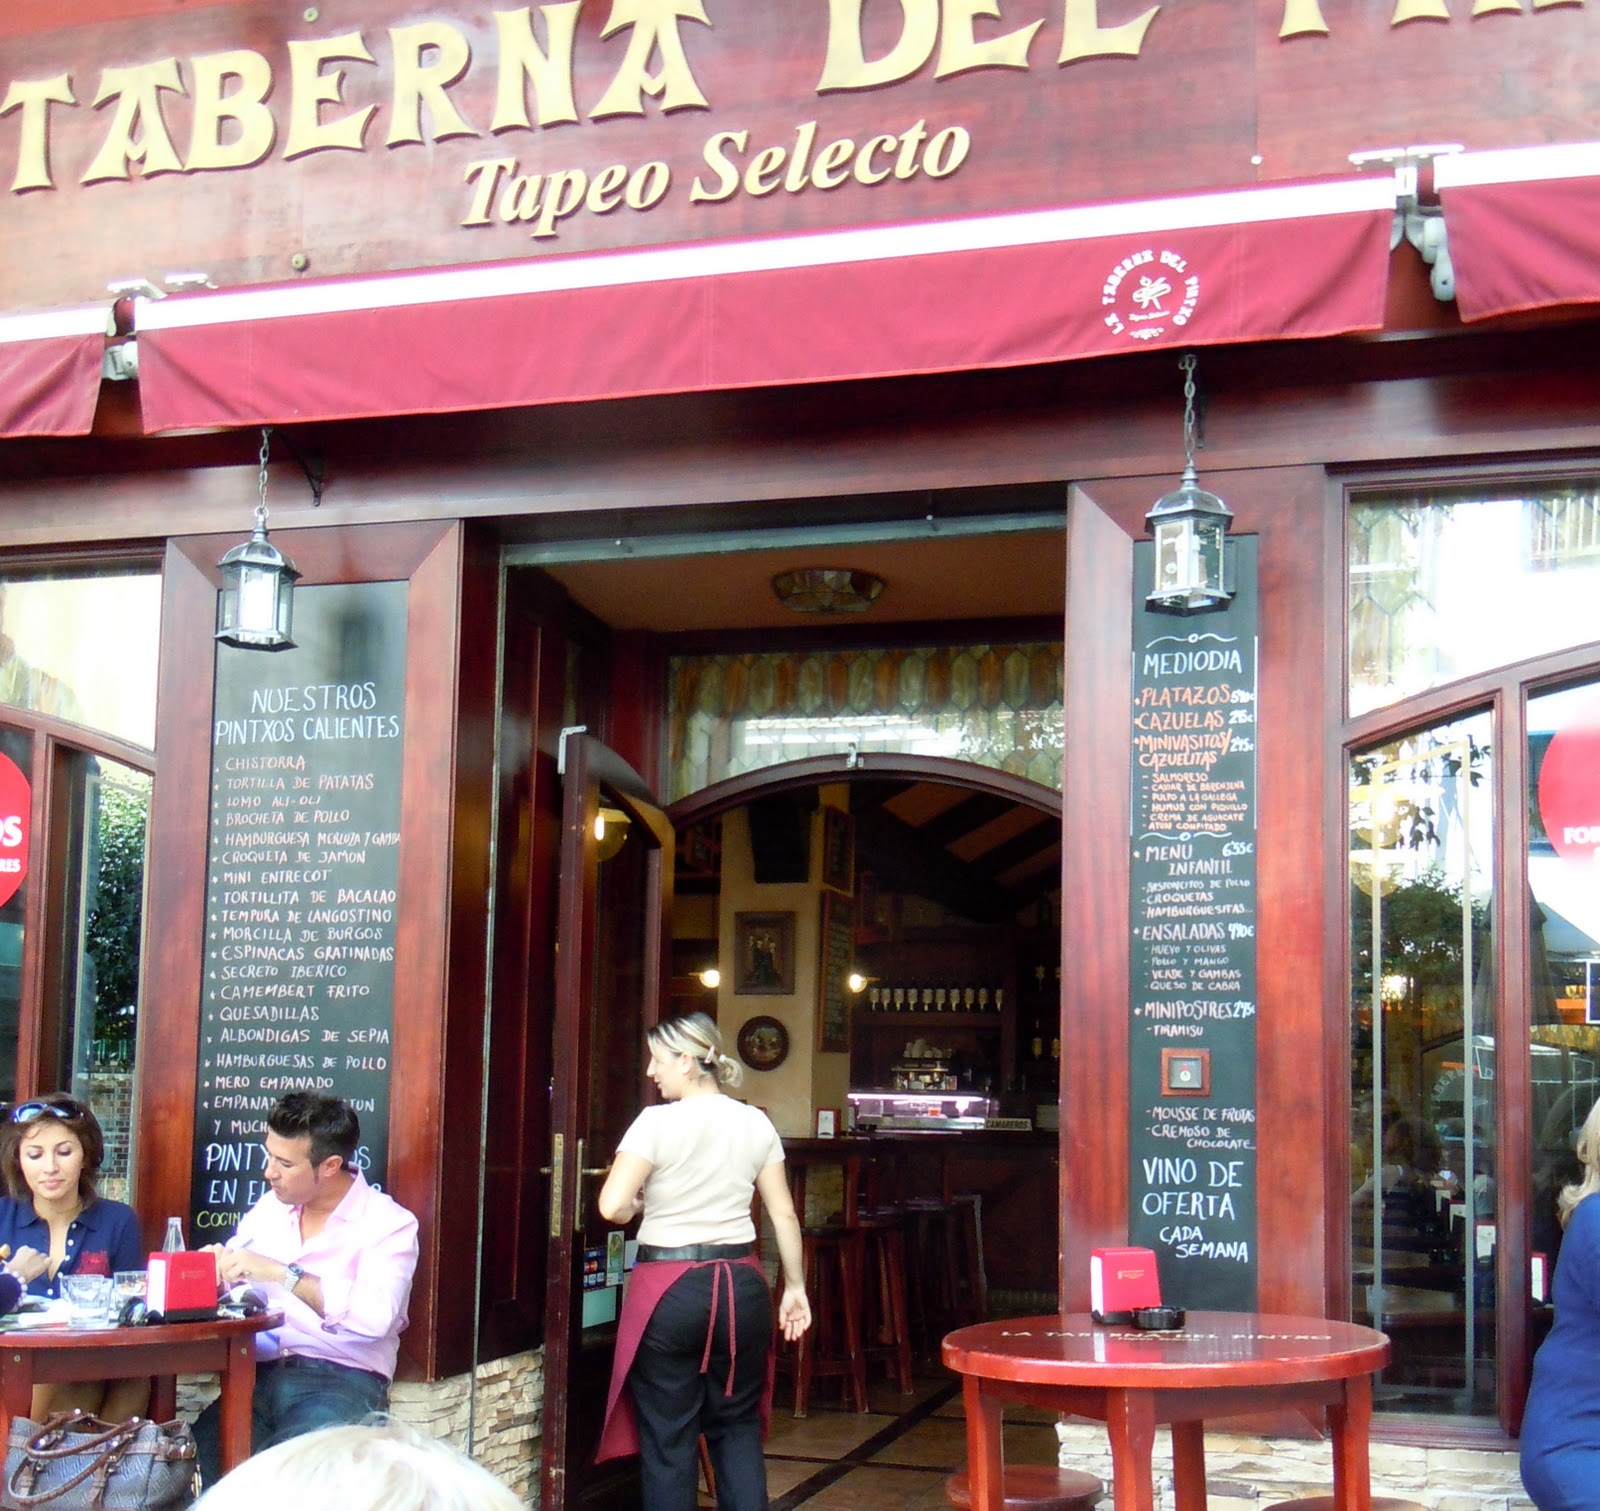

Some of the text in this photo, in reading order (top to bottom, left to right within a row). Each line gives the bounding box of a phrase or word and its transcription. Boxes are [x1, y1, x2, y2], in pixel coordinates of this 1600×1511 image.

[0, 0, 713, 194] TABERNA
[461, 119, 971, 239] Tapeo Selecto
[1160, 250, 1188, 273] DEL
[1143, 649, 1242, 678] MEDIODIA
[251, 682, 377, 714] NUESTROS
[1142, 684, 1231, 708] PLATAZOS
[214, 714, 400, 745] PINTXOS CALIENTES
[1139, 710, 1224, 732] CAZUELAS
[226, 755, 305, 771] CHISTORRA
[1139, 751, 1217, 772] CAZUELITAS
[227, 773, 374, 790] TORTILLA DE PATATAS
[1152, 772, 1208, 783] SALMOREJO
[1152, 783, 1182, 792] CAVIAR
[1200, 780, 1245, 792] BERENJENA
[227, 796, 262, 807] LOMO
[1152, 793, 1177, 801] PULPO
[1189, 794, 1199, 803] LA
[1201, 793, 1237, 802] GALLEGA
[1152, 803, 1185, 813] HUMUS
[226, 810, 350, 826] BROCHETA DE POLLO
[1187, 814, 1198, 822] DE
[1201, 813, 1244, 821] AGUACATE
[1148, 822, 1227, 832] ATUN CONFITADO
[225, 831, 310, 847] HAMBURGUESA
[222, 850, 365, 864] CROQUETA DE JAMON
[1145, 844, 1193, 862] MENU
[1169, 858, 1233, 875] INFANTIL
[223, 869, 332, 885] MINI ENTRECOT
[1210, 880, 1221, 889] DE
[223, 888, 396, 905] TORTILLITA DE BACALAO
[1146, 892, 1214, 904] CROQUETAS
[221, 909, 392, 924] TEMPURA DE LANGOSTINO
[223, 926, 383, 944] MORCILLA DE BURGOS
[1142, 922, 1225, 941] ENSALADAS
[221, 946, 394, 963] ESPINACAS GRATINADAS
[1151, 944, 1180, 955] HUEVO
[1193, 945, 1226, 954] OLIVAS
[1152, 957, 1176, 966] POLLO
[1194, 957, 1229, 966] MANGO
[221, 964, 347, 980] SECRETO IBERICO
[1198, 970, 1241, 979] GAMBAS
[220, 984, 370, 1001] CAMEMBERT FRITO
[1150, 982, 1241, 991] QUESO DE CABRA
[219, 1005, 320, 1023] QUESADILLAS
[1145, 1000, 1233, 1020] MINIPOSTRES
[220, 1027, 389, 1045] ALBONDIGAS DE SEPIA
[1154, 1024, 1204, 1037] TIRAMISU
[216, 1054, 387, 1071] HAMBURGUESAS DE POLLO
[215, 1076, 334, 1090] MERO EMPANADO
[214, 1094, 375, 1113] EMPANAD TUN
[1152, 1106, 1255, 1123] MOUSSE DE FRUTAS
[214, 1119, 268, 1136] Y MUCH
[1151, 1124, 1231, 1138] CREMOSO DE
[206, 1142, 269, 1171] PINTX
[1143, 1156, 1244, 1187] VINO DE
[209, 1178, 238, 1204] EN
[1142, 1192, 1235, 1221] OFERTA
[196, 1210, 241, 1228] COCIN
[1159, 1225, 1203, 1245] CADA
[1176, 1241, 1248, 1263] SEMANA
